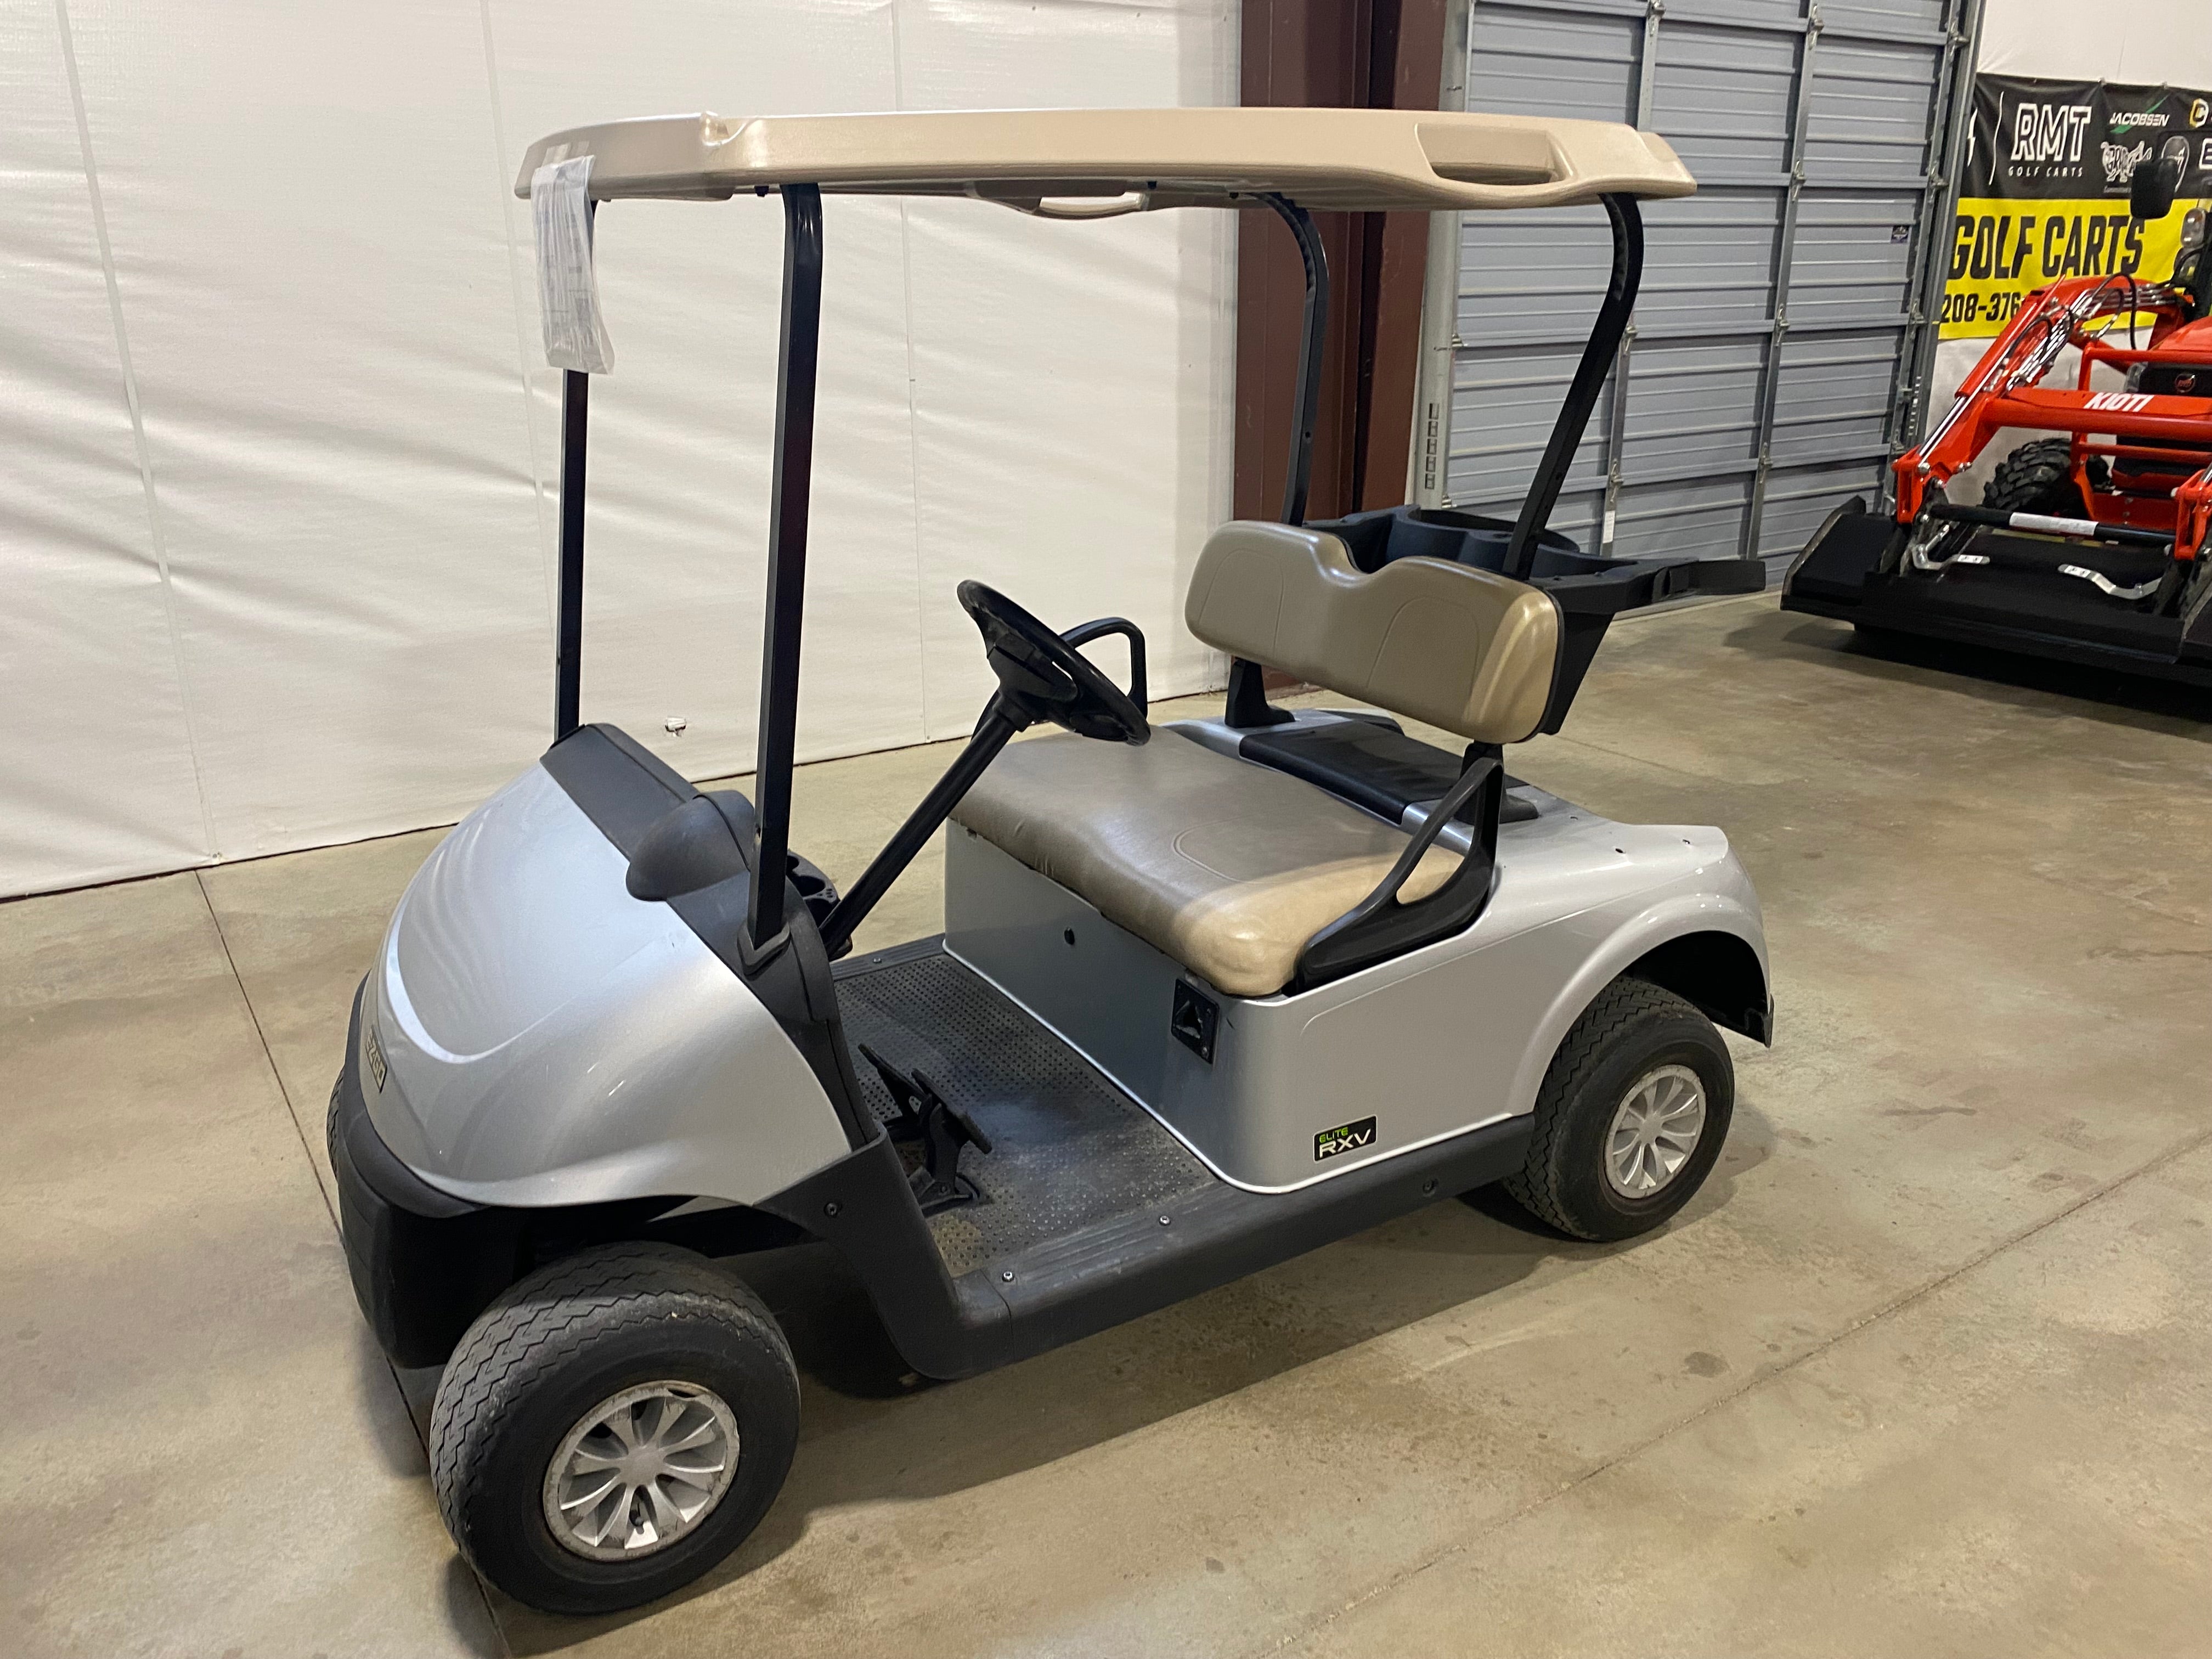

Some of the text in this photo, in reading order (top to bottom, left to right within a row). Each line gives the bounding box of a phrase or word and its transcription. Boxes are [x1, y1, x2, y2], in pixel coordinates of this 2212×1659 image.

[2109, 112, 2170, 127] JACOBSEN
[2011, 103, 2092, 162] RMT
[2008, 166, 2083, 177] GOLF CARTS
[1948, 215, 2145, 280] GOLF CARTS
[2084, 392, 2154, 412] KIOTI
[1319, 1127, 1348, 1143] ELITE
[1319, 1128, 1371, 1158] RXV
